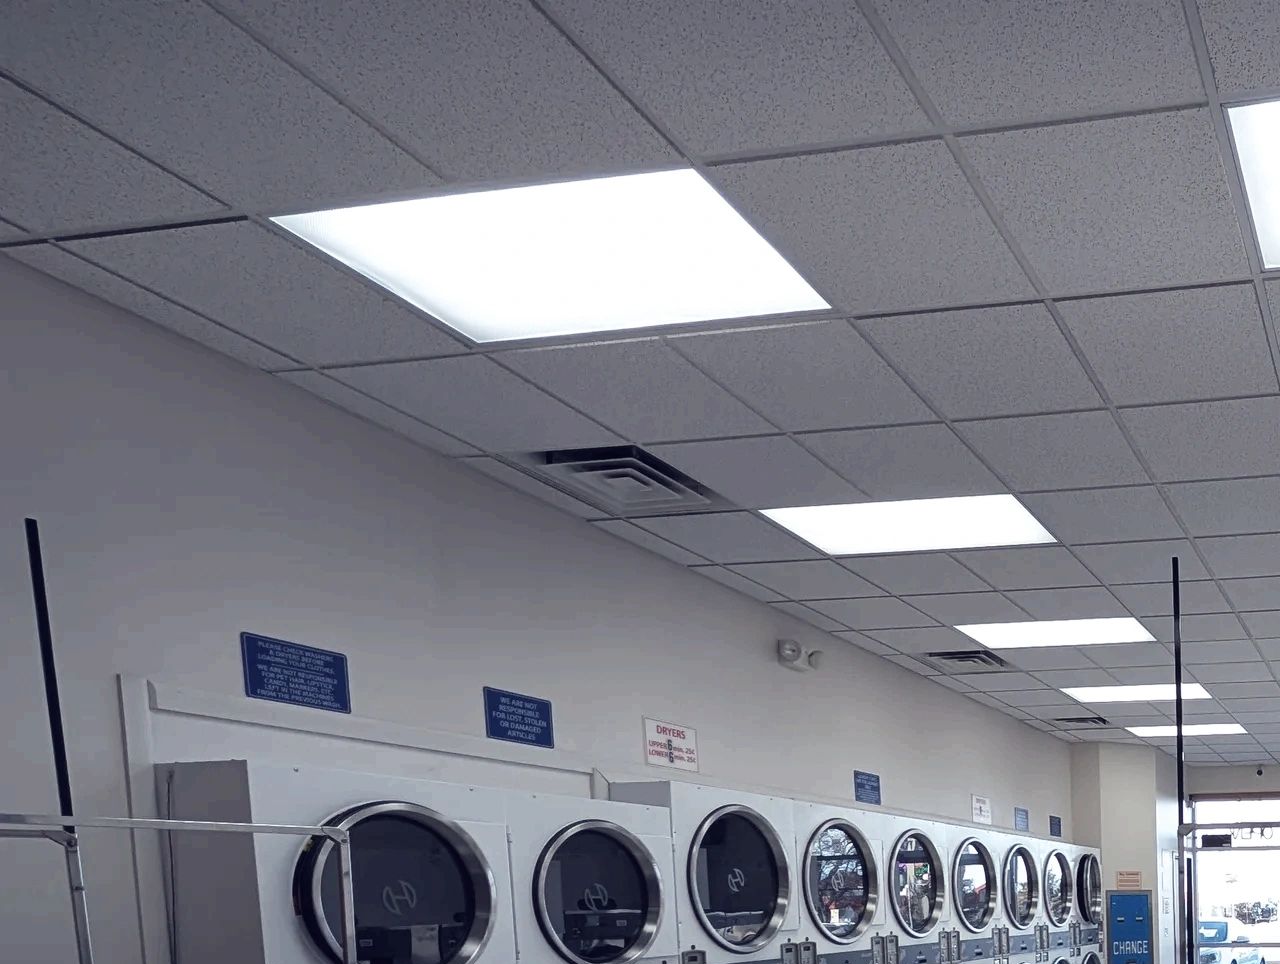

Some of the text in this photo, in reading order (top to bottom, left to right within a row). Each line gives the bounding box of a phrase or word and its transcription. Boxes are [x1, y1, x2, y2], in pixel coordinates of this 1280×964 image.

[258, 642, 281, 651] PLEASE
[284, 646, 303, 655] CHECK
[289, 660, 306, 668] YOUR
[302, 656, 324, 665] BEFORE
[283, 668, 296, 676] NOT
[298, 672, 338, 684] RESPONSIBLE
[500, 696, 510, 704] WE
[525, 702, 537, 710] NOT
[499, 705, 539, 718] RESPONSIBLE
[492, 710, 506, 719] FOR
[524, 717, 547, 727] STOLEN
[500, 720, 541, 733] OR DAMAGED
[656, 724, 686, 739] DRYERS
[508, 730, 536, 740] ARTICLES
[649, 740, 667, 749] UPPER
[668, 739, 672, 750] 6
[649, 749, 668, 758] LOWER
[669, 752, 674, 763] 6
[1113, 940, 1148, 954] CHANGE
